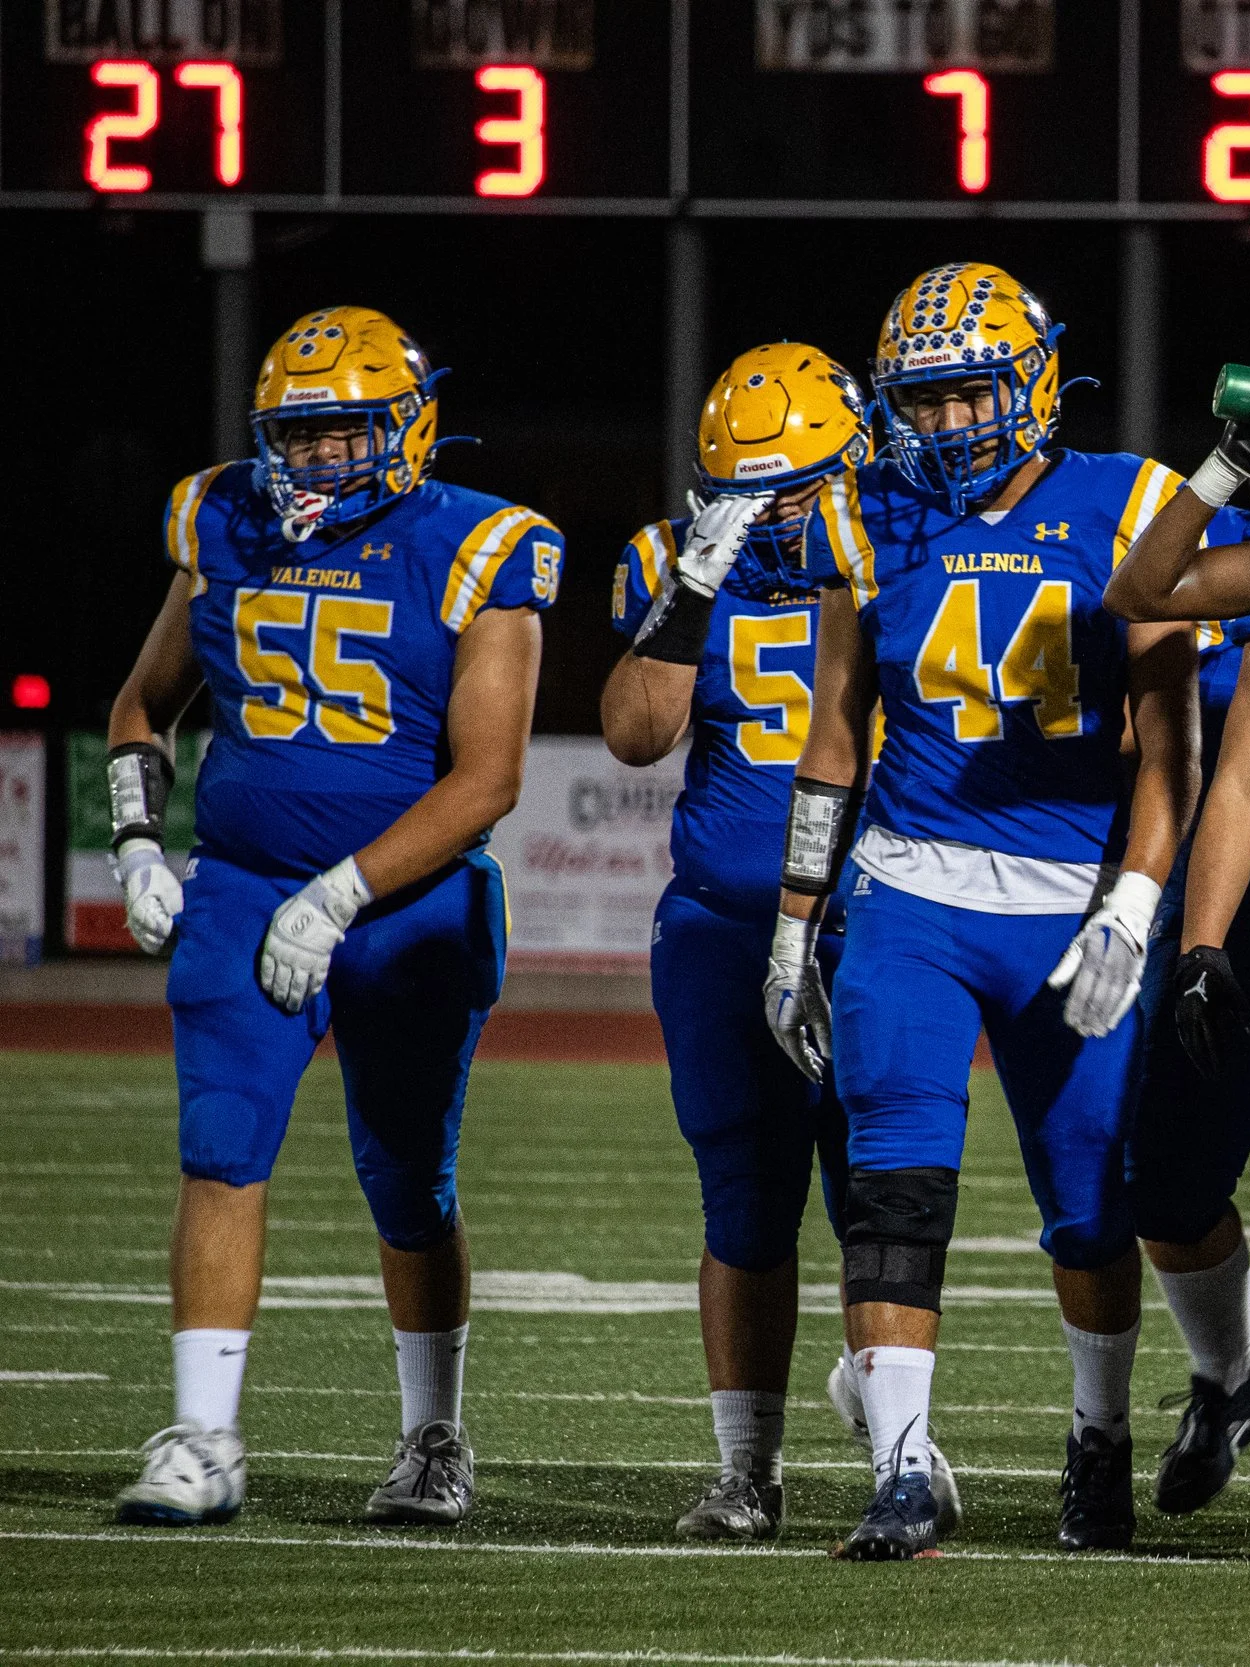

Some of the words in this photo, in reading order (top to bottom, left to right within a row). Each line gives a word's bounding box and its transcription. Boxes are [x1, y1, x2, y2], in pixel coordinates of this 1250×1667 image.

[84, 59, 242, 191] 27
[475, 64, 544, 197] 3
[923, 68, 990, 192] 7
[909, 353, 951, 367] Riddell
[739, 460, 782, 472] Riddell
[271, 566, 362, 590] VALENCIA
[942, 553, 1044, 574] VALENCIA
[234, 587, 396, 745] 55
[914, 578, 1083, 743] 44
